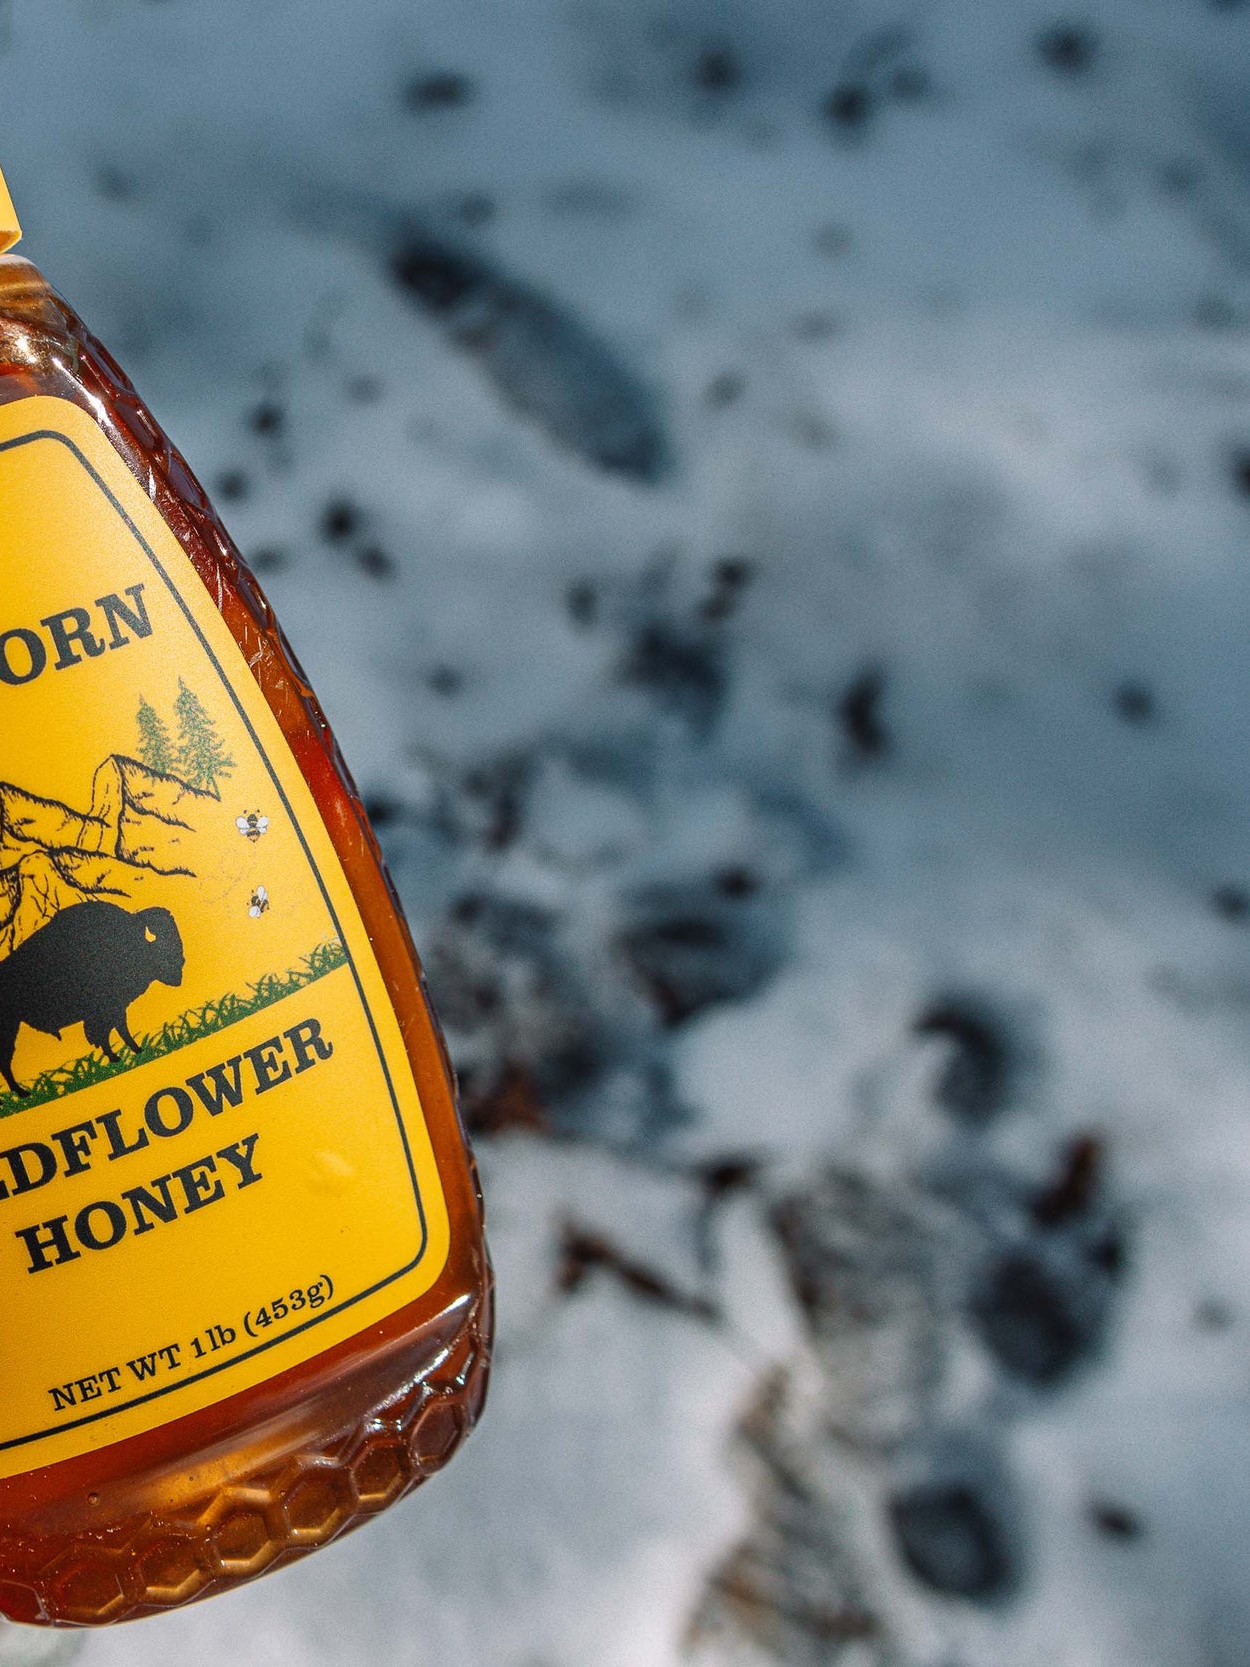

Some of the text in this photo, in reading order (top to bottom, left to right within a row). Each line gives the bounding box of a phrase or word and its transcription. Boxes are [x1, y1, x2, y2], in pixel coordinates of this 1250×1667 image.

[15, 1133, 264, 1274] HONEY
[48, 1367, 122, 1411] NET
[126, 1343, 182, 1382] WT
[243, 1274, 335, 1337] (453g)
